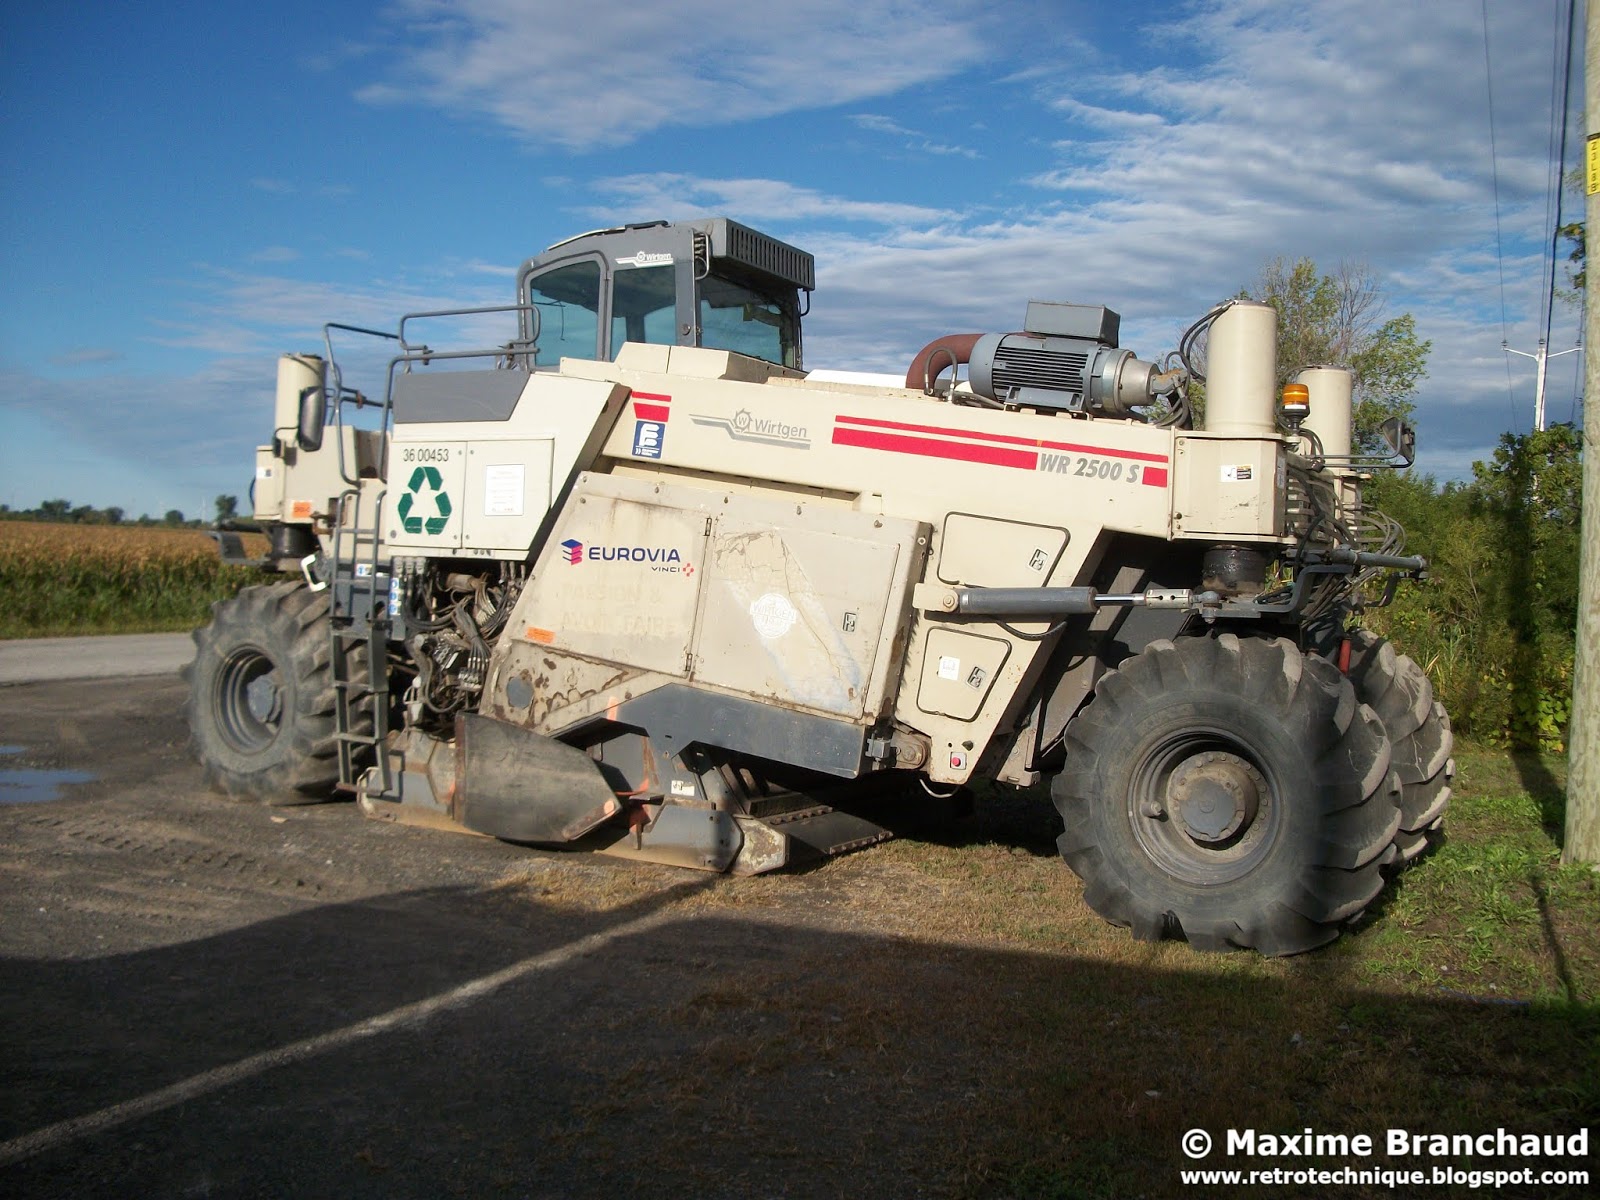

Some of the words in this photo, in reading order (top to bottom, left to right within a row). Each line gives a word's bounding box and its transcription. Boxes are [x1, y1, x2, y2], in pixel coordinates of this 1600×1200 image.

[755, 419, 807, 440] Wirtgen
[403, 448, 415, 462] 36
[417, 448, 449, 462] 00453
[1040, 453, 1071, 474] WR
[1074, 457, 1123, 481] 2500
[1126, 464, 1140, 483] S
[588, 546, 681, 563] EUROVIA
[651, 566, 680, 574] VINCI
